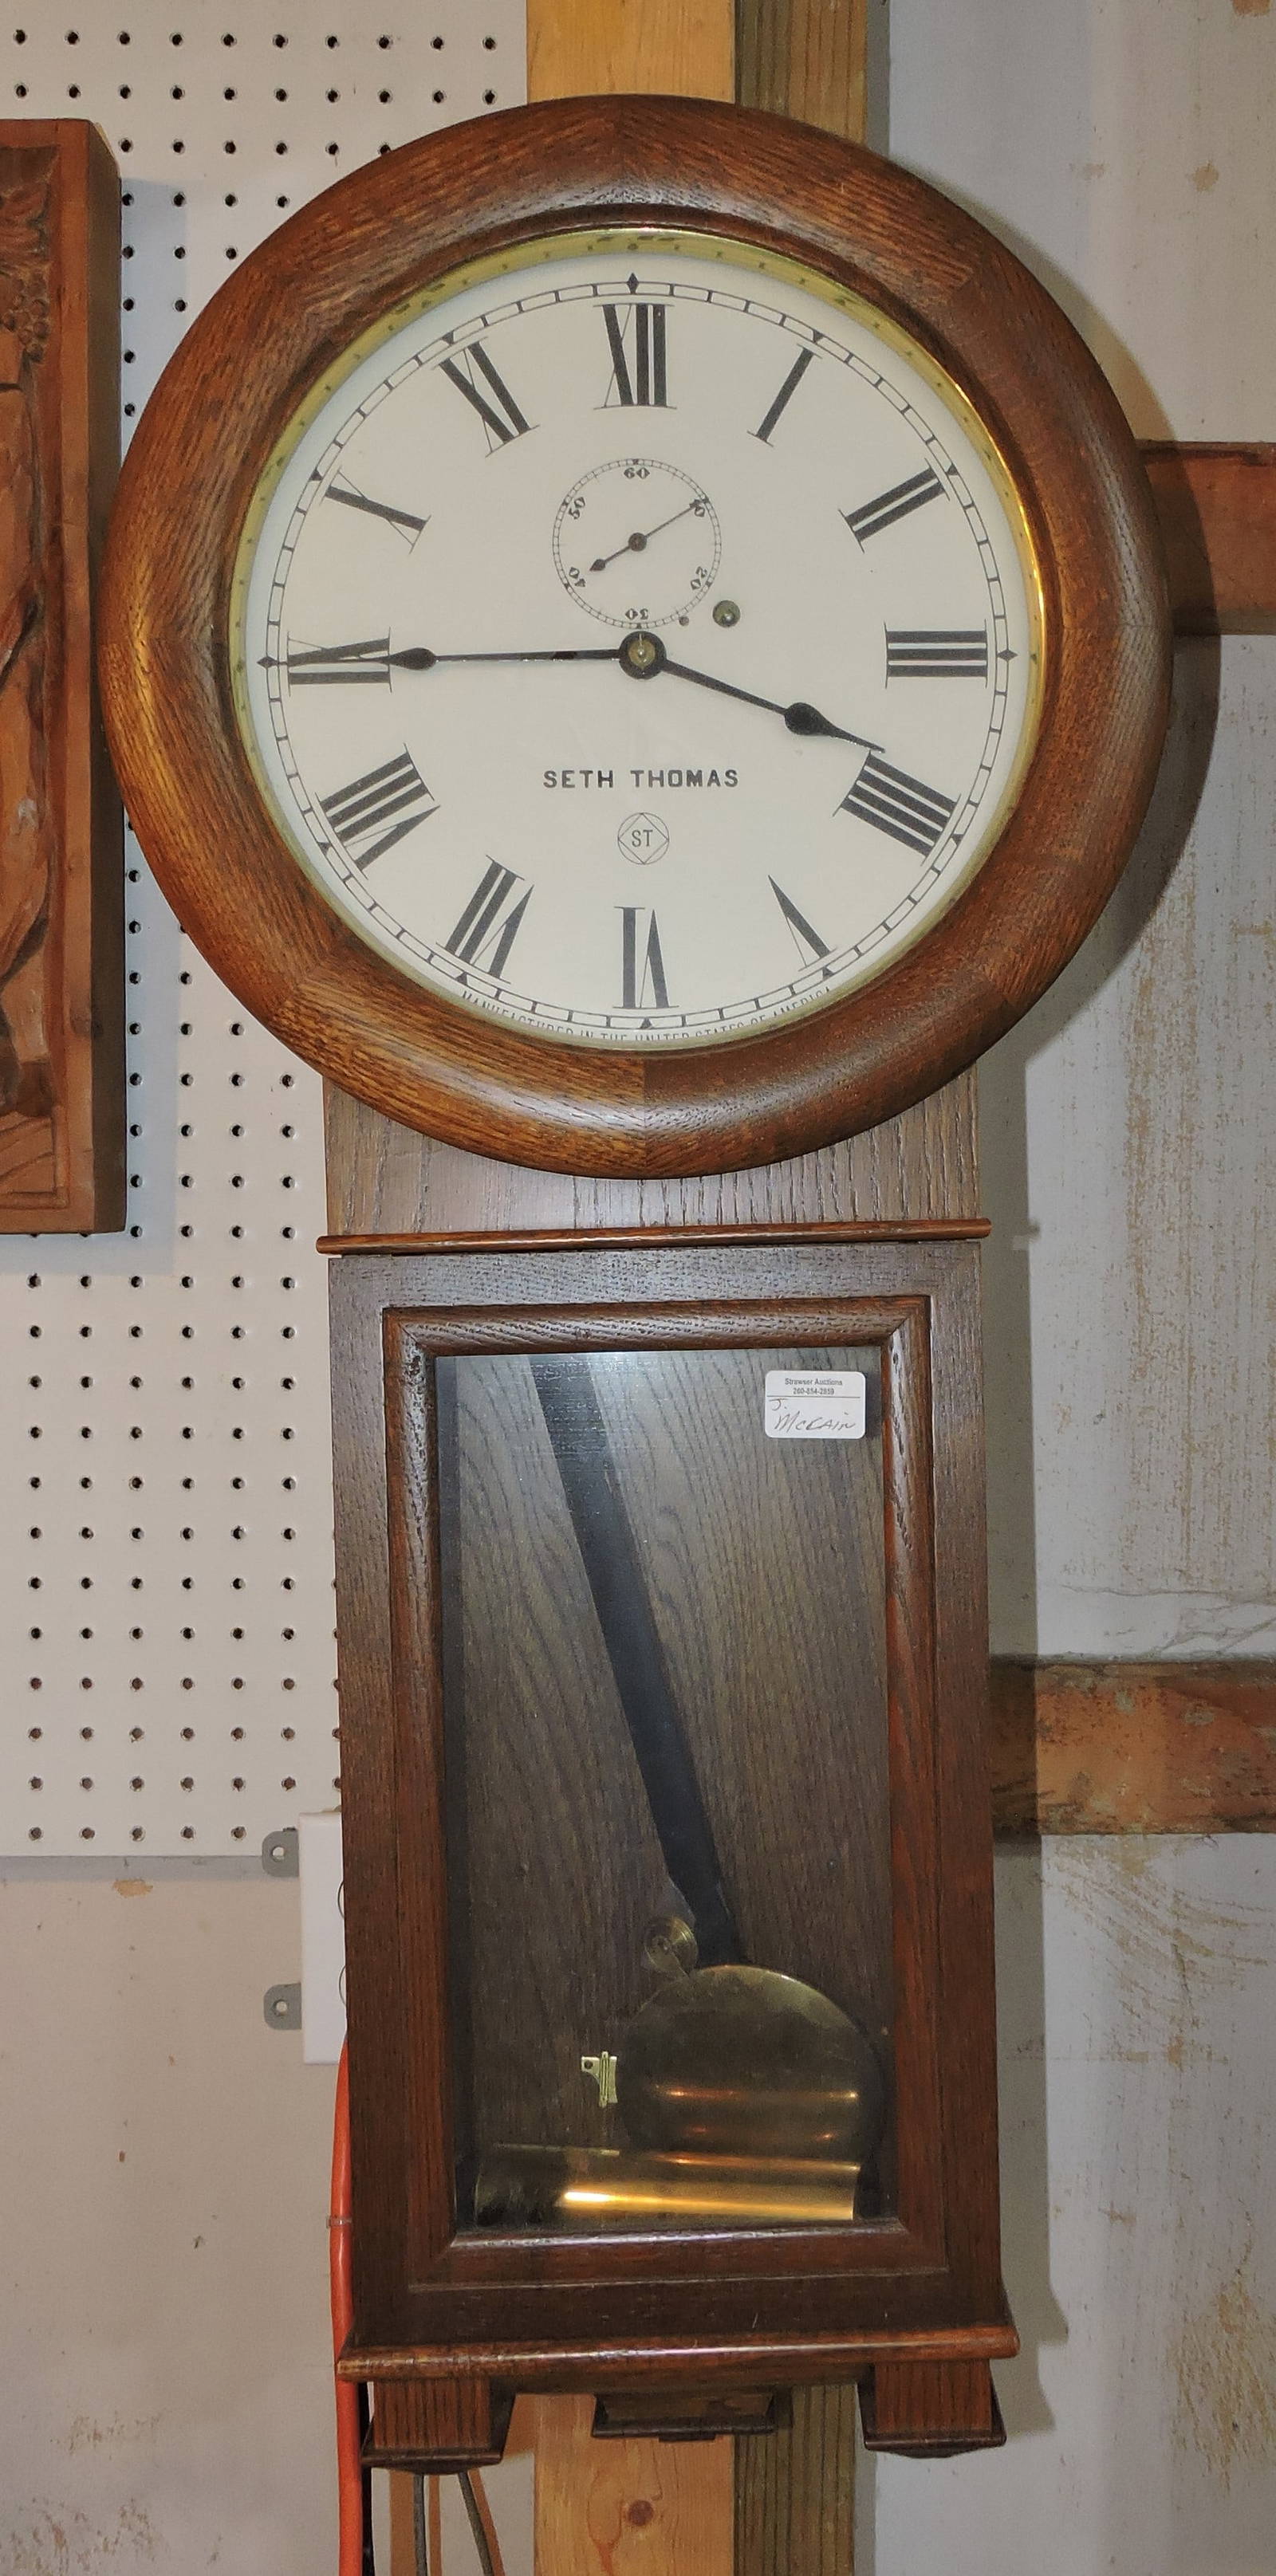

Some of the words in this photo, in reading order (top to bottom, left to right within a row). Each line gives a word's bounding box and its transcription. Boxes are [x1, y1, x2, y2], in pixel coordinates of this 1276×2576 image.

[593, 303, 677, 409] XII
[433, 336, 540, 458] XI
[746, 344, 824, 448] I
[319, 467, 431, 555] X
[568, 496, 586, 520] 50
[624, 467, 651, 479] 60
[838, 457, 951, 553] II
[569, 567, 587, 588] 40
[625, 608, 649, 620] 30
[690, 565, 709, 590] 20
[884, 619, 988, 690] III
[315, 743, 441, 880] VIII
[543, 769, 614, 789] SETH
[630, 769, 738, 789] THOMAS
[631, 829, 653, 848] ST
[436, 855, 534, 985] VII
[612, 907, 679, 1009] VI
